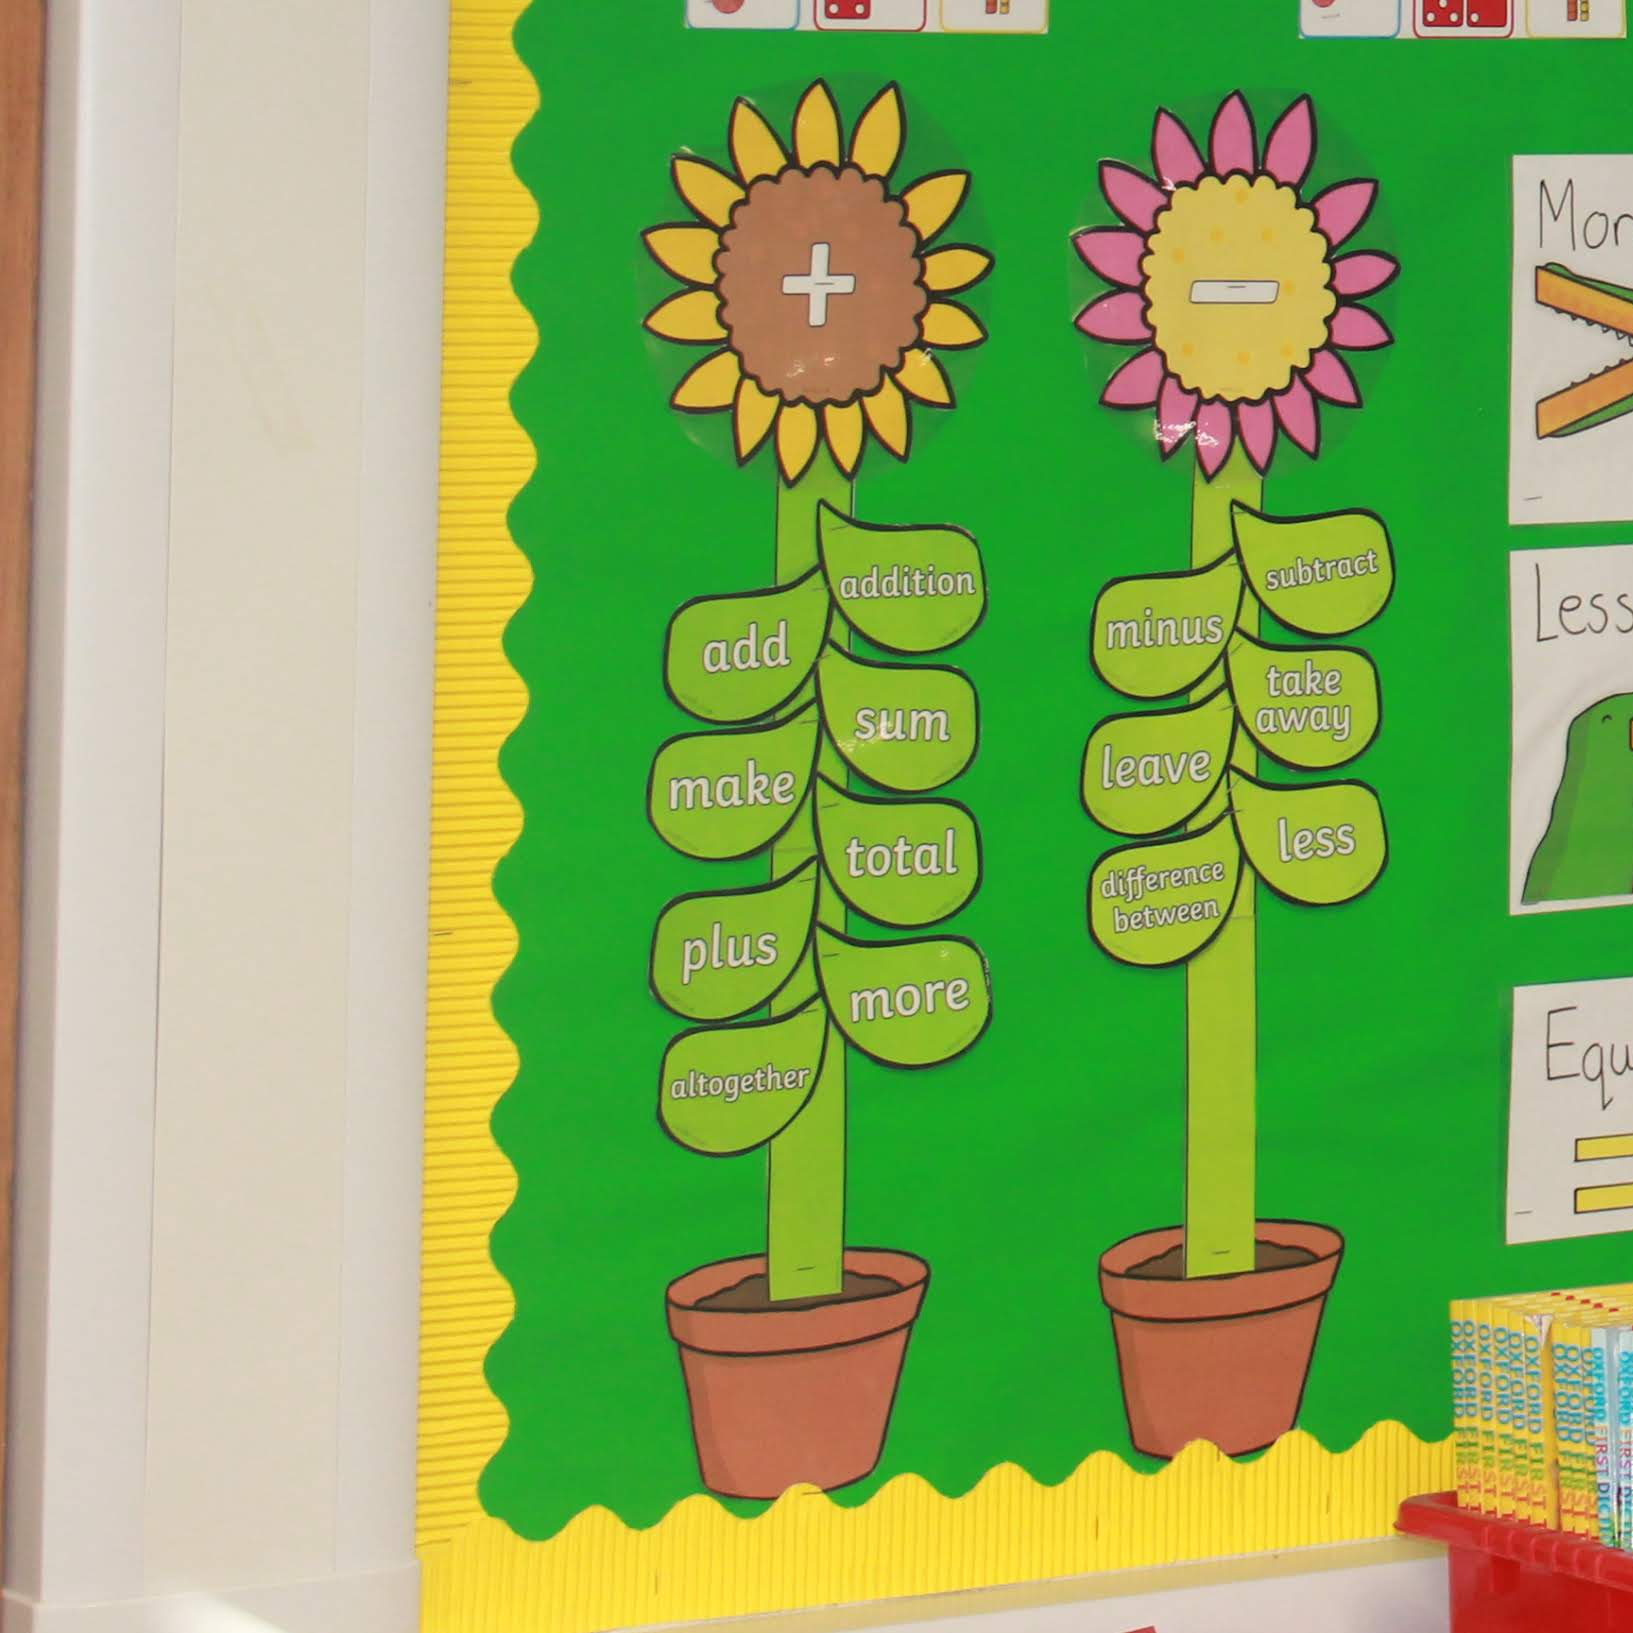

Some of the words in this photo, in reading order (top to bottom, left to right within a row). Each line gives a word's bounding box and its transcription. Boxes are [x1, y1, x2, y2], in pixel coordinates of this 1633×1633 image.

[839, 568, 976, 600] addition
[1265, 549, 1379, 591] subtract
[703, 620, 790, 673] add
[1105, 609, 1225, 649] minus
[1266, 660, 1343, 698] take
[855, 705, 950, 742] sum
[1255, 703, 1352, 741] away
[668, 760, 796, 810] make
[1100, 745, 1212, 788] leave
[845, 829, 958, 878] total
[1278, 818, 1355, 863] less
[1100, 860, 1225, 902] difference
[1113, 896, 1220, 935] between
[681, 923, 778, 984] plus
[850, 976, 969, 1023] more
[670, 1064, 809, 1103] altogether
[1525, 1336, 1543, 1434] OXFORD
